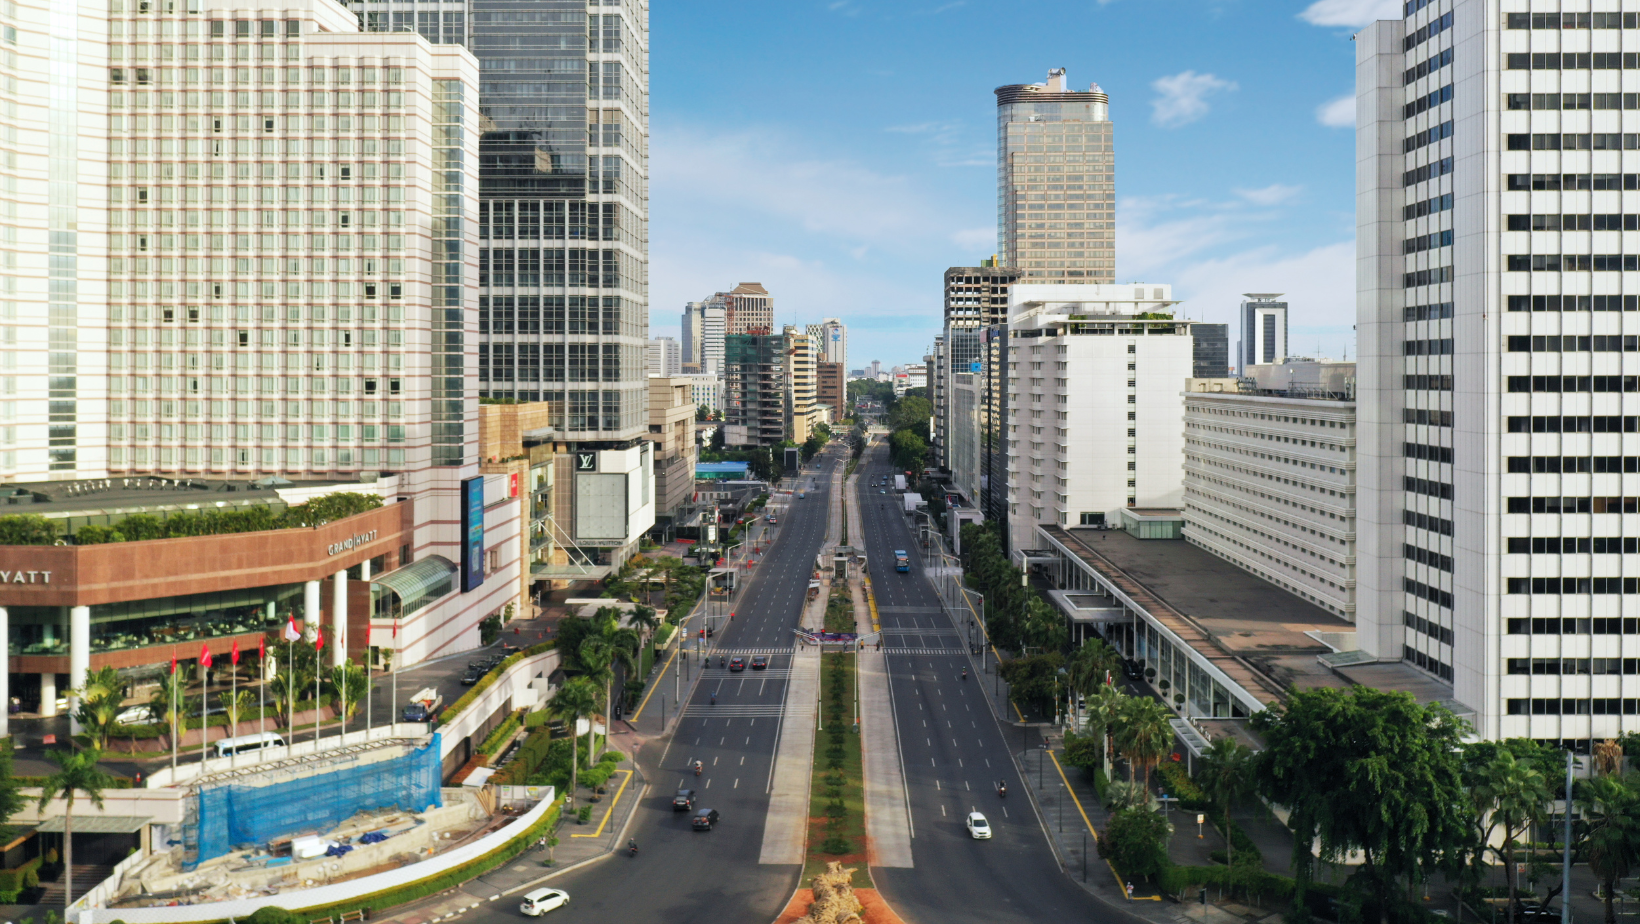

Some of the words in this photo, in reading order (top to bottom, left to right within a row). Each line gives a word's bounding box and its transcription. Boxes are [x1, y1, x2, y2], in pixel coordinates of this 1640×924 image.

[328, 538, 353, 556] GRAND
[355, 529, 377, 546] HYATT
[0, 570, 52, 583] YATT
